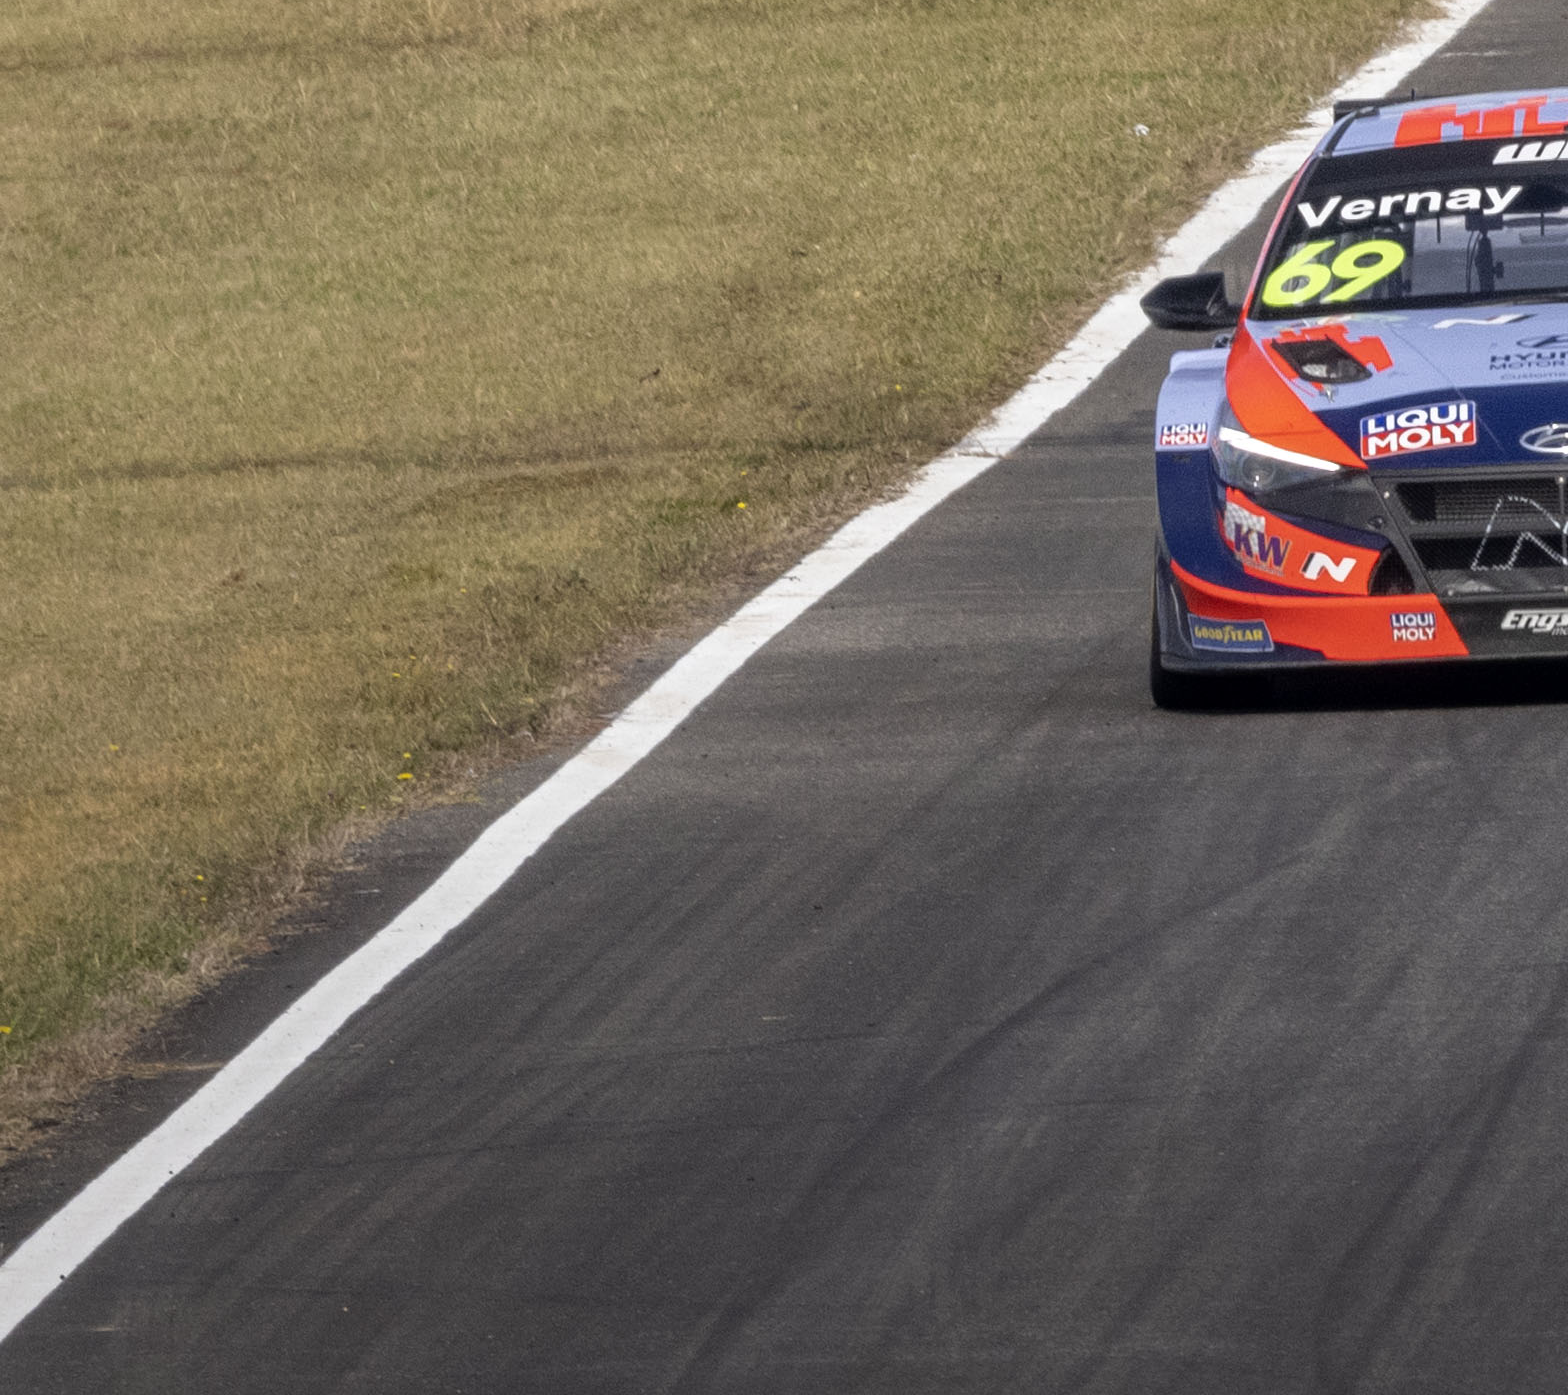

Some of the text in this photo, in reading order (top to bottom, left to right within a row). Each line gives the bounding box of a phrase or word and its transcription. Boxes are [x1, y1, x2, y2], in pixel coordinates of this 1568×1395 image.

[1296, 184, 1524, 230] Vernay
[1261, 238, 1406, 309] 69
[1162, 422, 1207, 435] LIQUI
[1366, 401, 1471, 435] LIQUI
[1160, 432, 1206, 446] MOLY
[1366, 422, 1473, 458] MOLY
[1233, 522, 1291, 569] KW
[1390, 612, 1435, 628] LIQUI
[1193, 624, 1264, 644] GOODYEAR
[1392, 627, 1436, 643] MOLY
